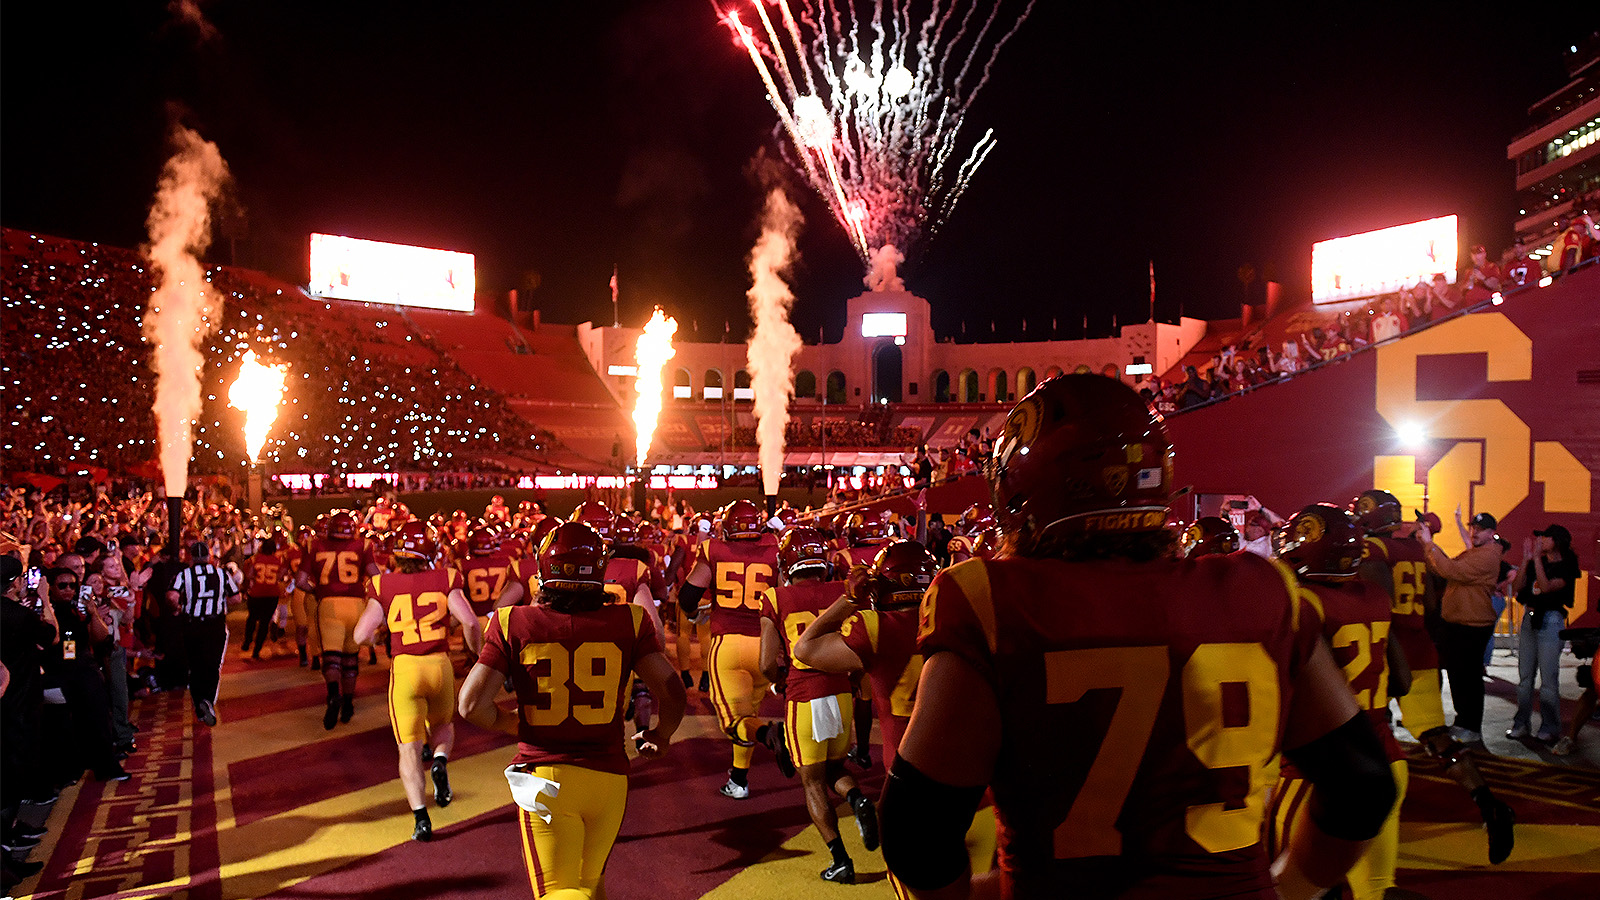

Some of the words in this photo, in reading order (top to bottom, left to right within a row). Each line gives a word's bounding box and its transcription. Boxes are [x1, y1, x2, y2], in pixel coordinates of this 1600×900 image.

[197, 575, 215, 598] L
[254, 563, 279, 585] 35
[315, 551, 359, 585] 76
[467, 567, 506, 602] 67
[716, 562, 773, 610] 56
[1391, 561, 1428, 616] 65
[387, 591, 448, 646] 42
[519, 641, 623, 727] 39
[1332, 621, 1391, 711] 27
[1044, 642, 1281, 860] 79
